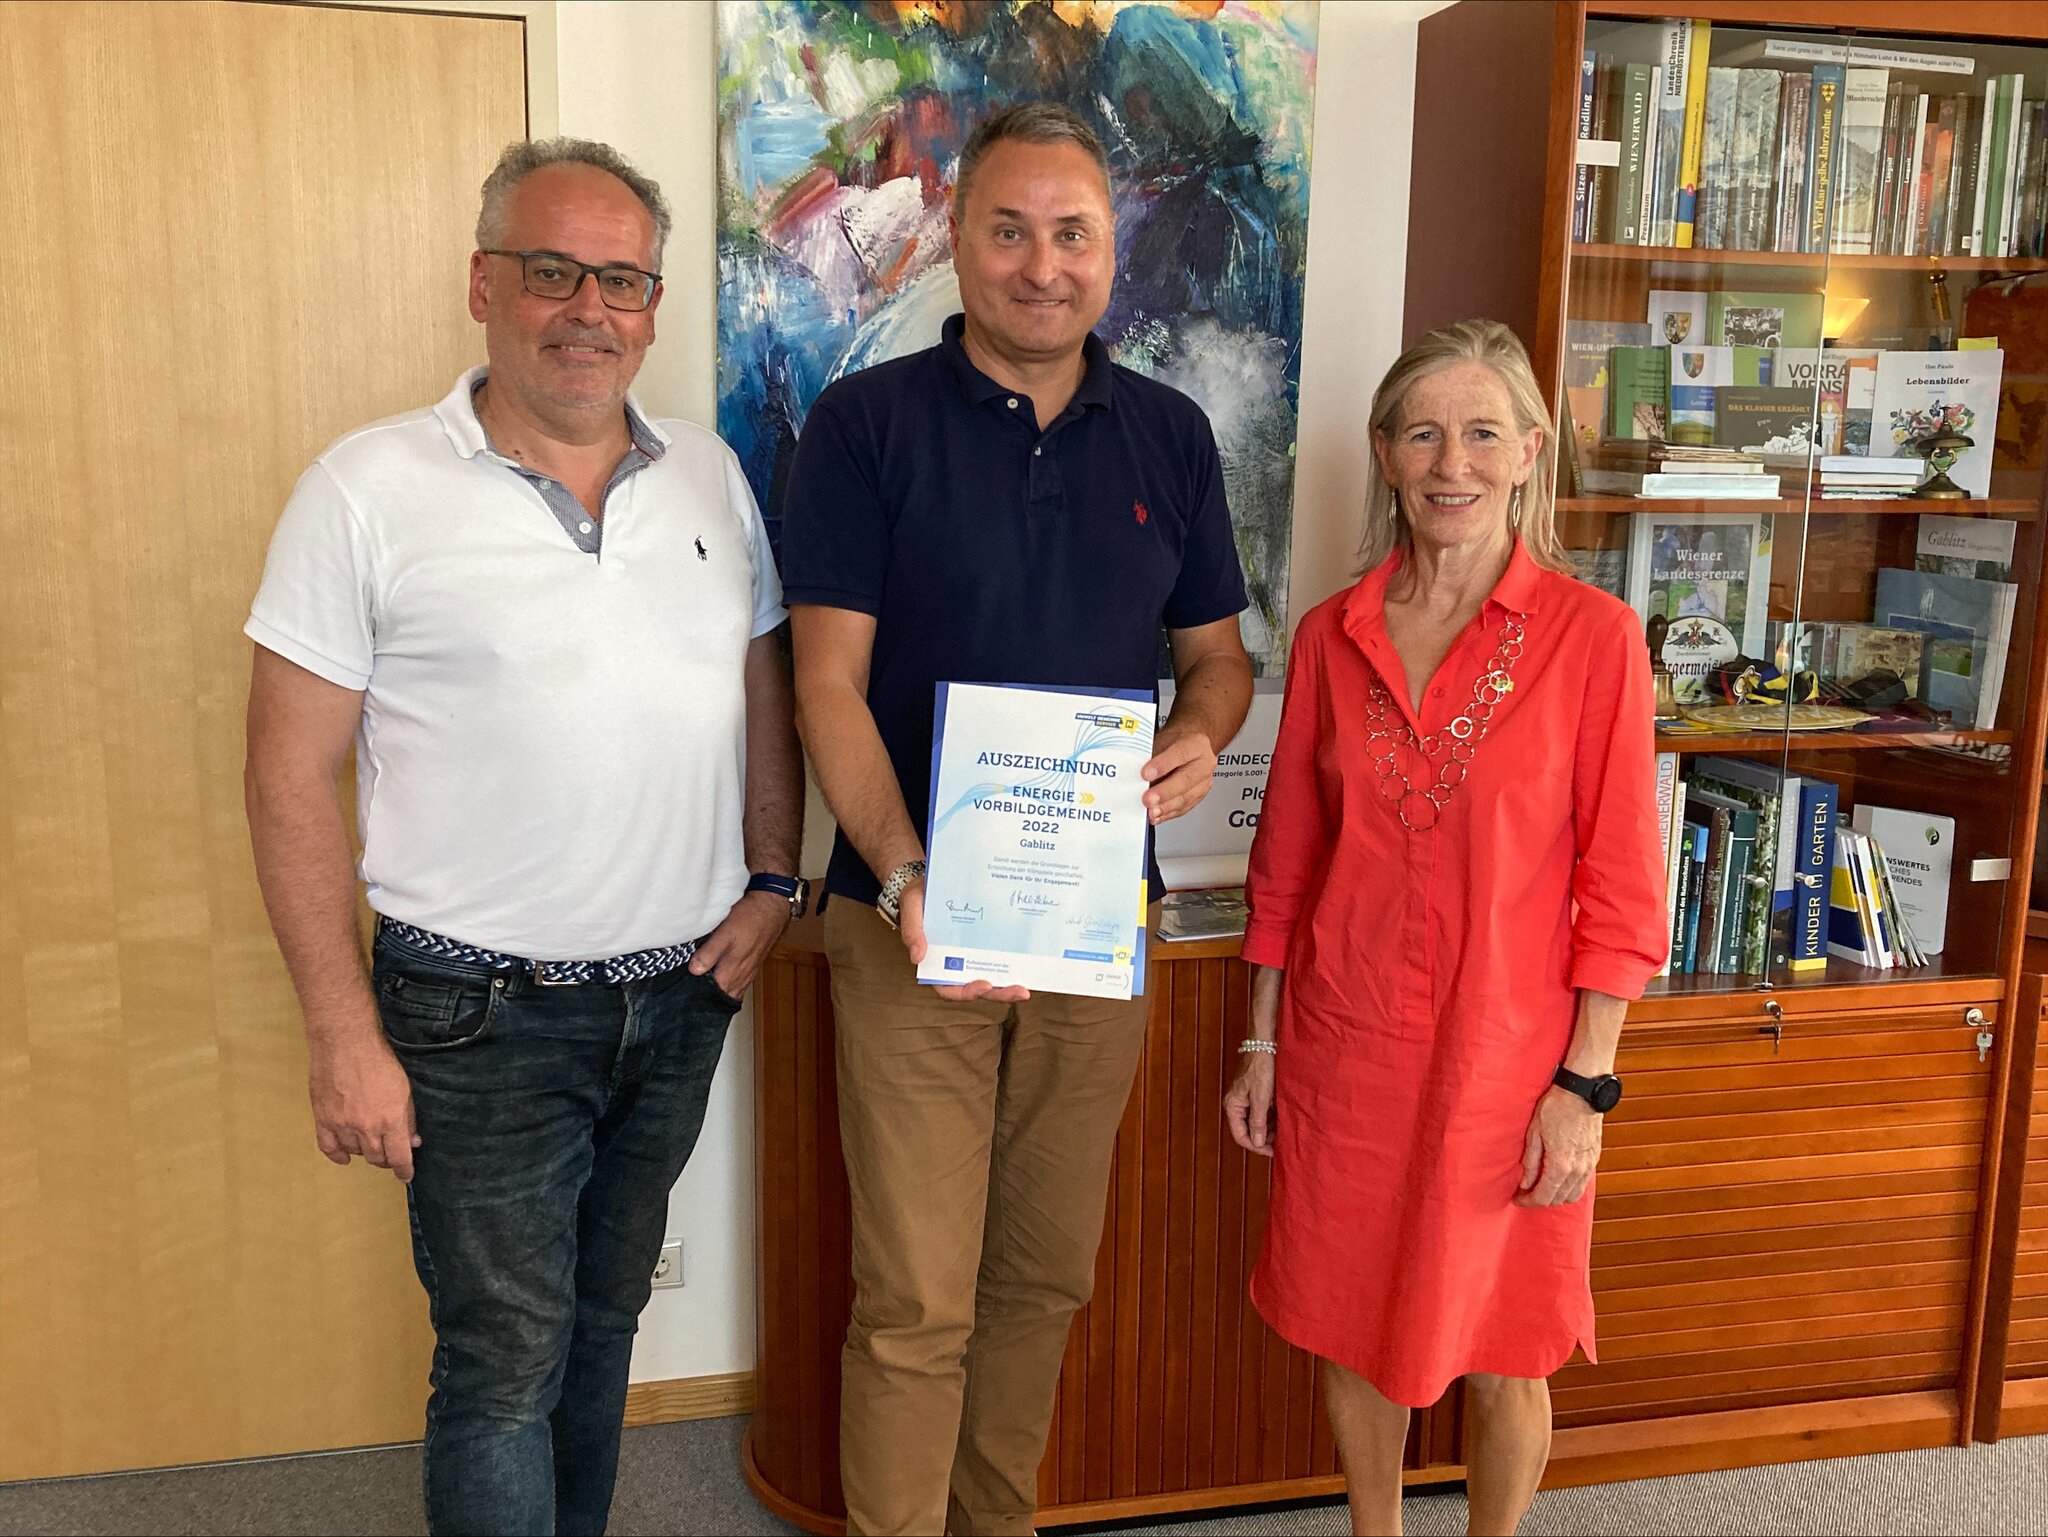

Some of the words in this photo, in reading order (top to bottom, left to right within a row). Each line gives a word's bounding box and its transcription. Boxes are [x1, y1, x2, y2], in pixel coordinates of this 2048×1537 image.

[1666, 32, 1678, 96] LandesChronik
[1674, 22, 1686, 96] NIEDERÖSTERREICH
[1630, 92, 1642, 172] WIENERWALD
[1818, 108, 1832, 160] Jahrzehnte
[1576, 164, 1587, 200] Sitzen
[1814, 161, 1828, 208] blau-gelbe
[1641, 194, 1650, 241] Pressbaum
[1813, 211, 1824, 230] Vier
[1788, 364, 1846, 378] VORRA
[1906, 378, 1970, 386] Lebensbilder
[1728, 404, 1743, 412] DAS
[1745, 404, 1776, 412] KLAVIER
[1778, 404, 1810, 413] ERZÄHLT
[1928, 531, 1966, 548] Gablitz
[1676, 550, 1724, 562] Wiener
[1654, 568, 1744, 580] Landesgrenze
[977, 752, 1117, 778] AUSZEICHNUNG
[1217, 754, 1272, 766] EINDEC
[1013, 786, 1075, 802] ENERGIE
[974, 799, 1111, 823] VORBILDGEMEINDE
[1022, 820, 1060, 834] 2022
[1812, 802, 1828, 866] GARTEN
[1020, 839, 1056, 850] Gablitz
[1044, 878, 1080, 886] Engagement!
[1680, 856, 1690, 896] Naturschutzes
[1676, 908, 1685, 942] Jahrhundert
[1806, 896, 1822, 956] KINDER
